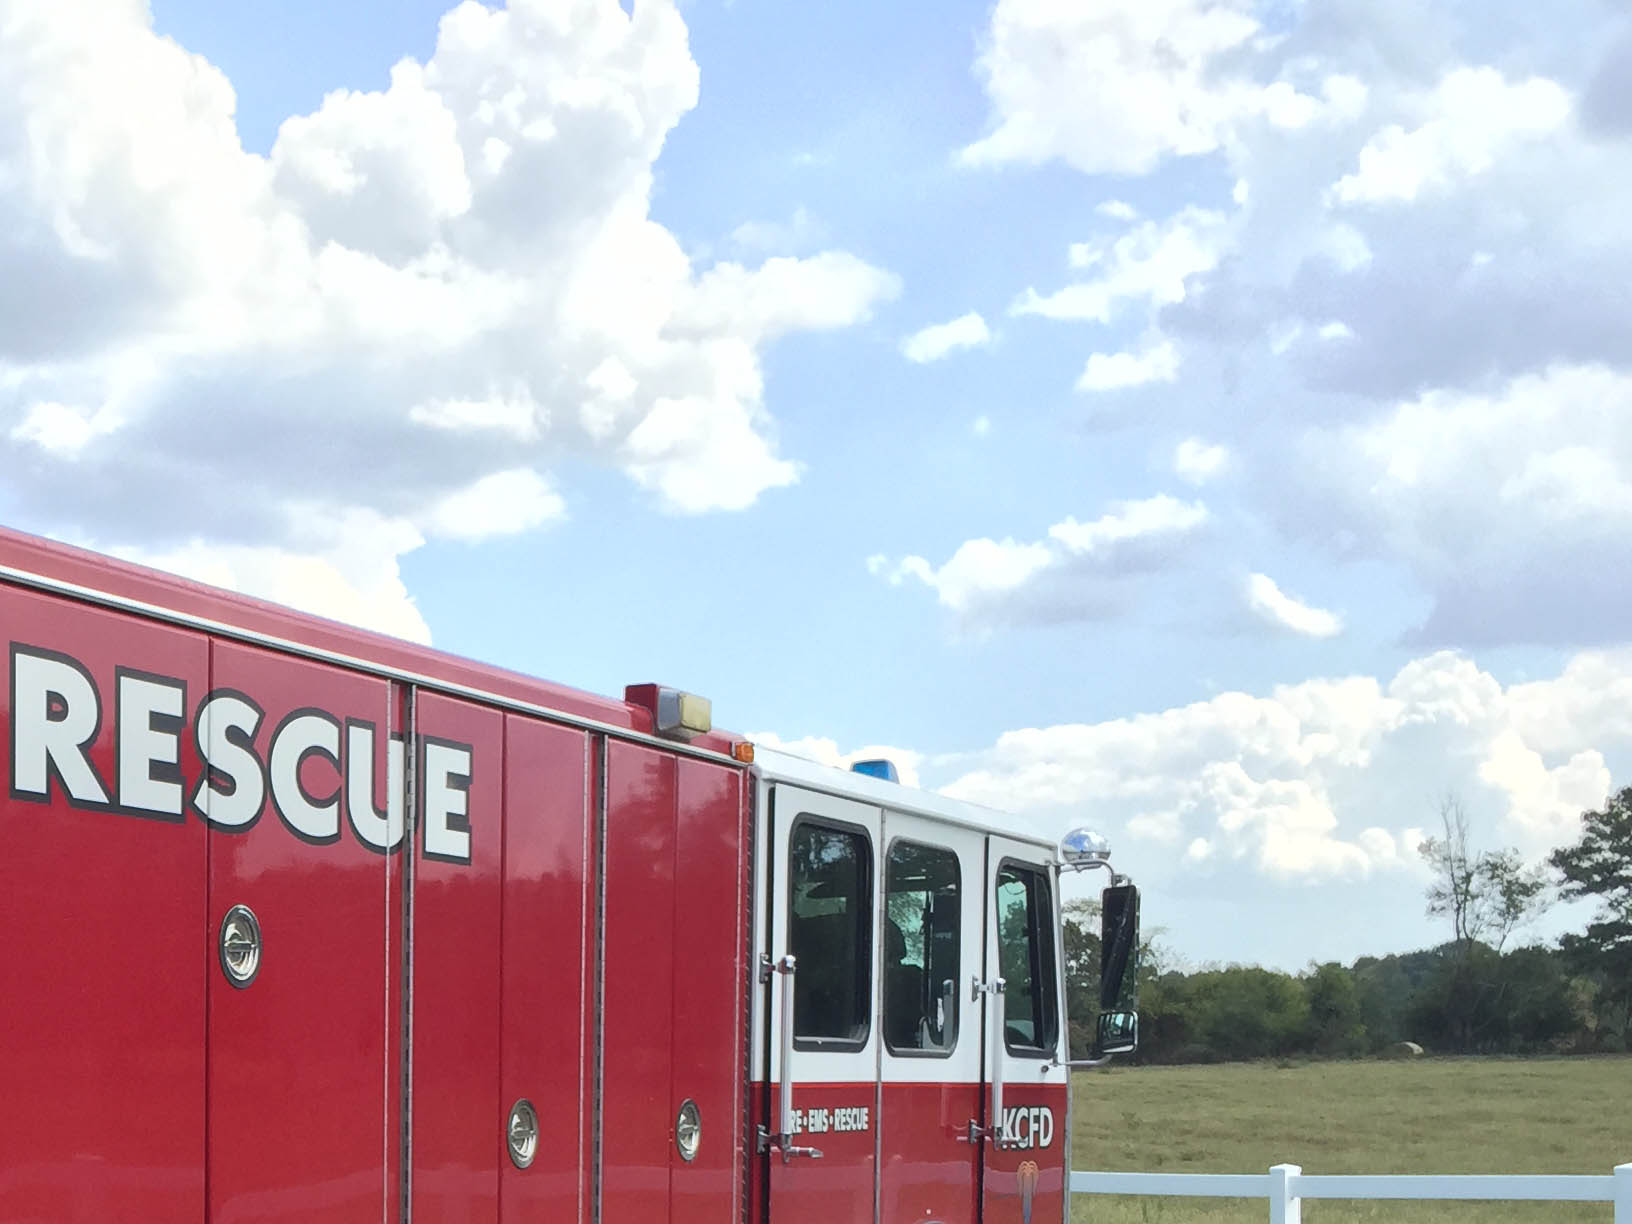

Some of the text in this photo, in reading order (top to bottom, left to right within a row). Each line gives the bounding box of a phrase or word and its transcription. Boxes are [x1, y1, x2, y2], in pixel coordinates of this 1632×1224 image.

[10, 642, 472, 865] RESCUE
[808, 1108, 828, 1133] EMS
[834, 1106, 869, 1131] RESCUE
[1002, 1106, 1054, 1149] KCFD
